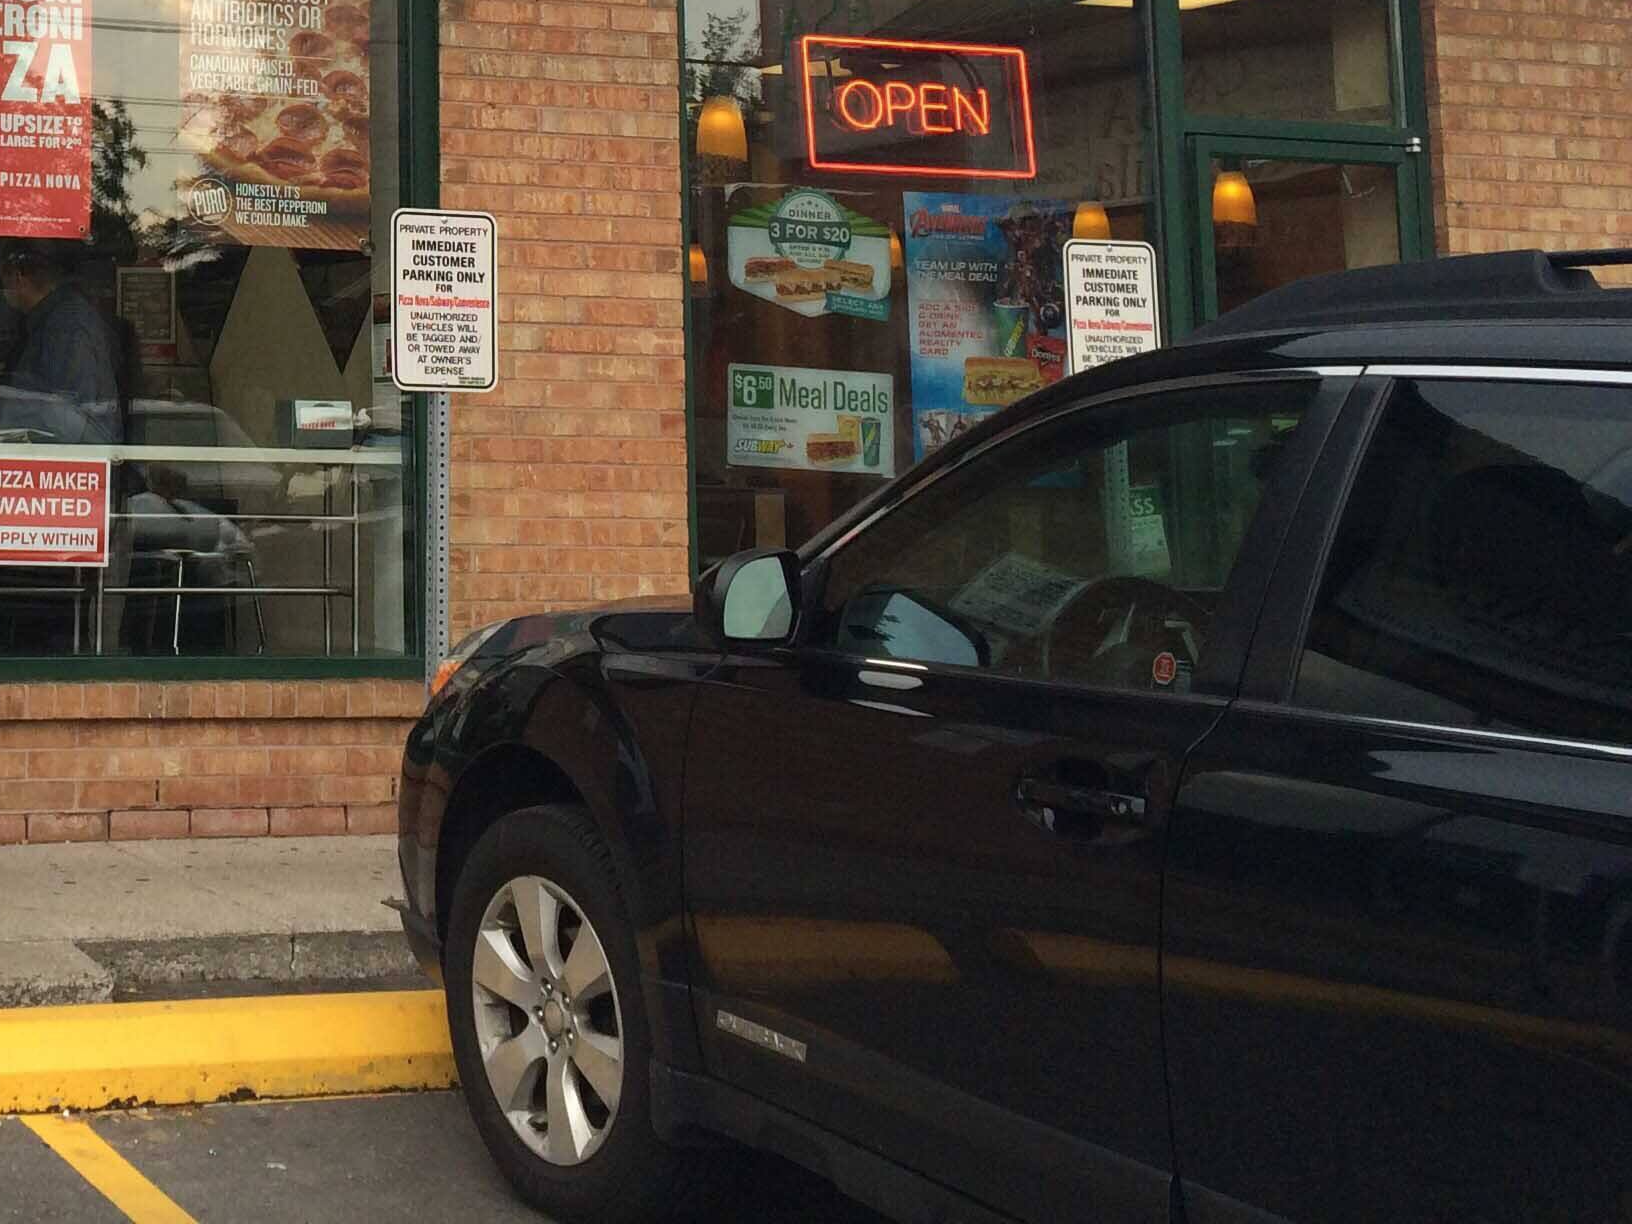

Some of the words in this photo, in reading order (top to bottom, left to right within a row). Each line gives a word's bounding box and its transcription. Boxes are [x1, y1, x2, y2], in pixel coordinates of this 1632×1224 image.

[299, 5, 321, 29] OR
[190, 54, 249, 73] CANADIAN
[190, 72, 254, 90] VEGETABLE
[838, 79, 990, 136] OPEN
[0, 113, 64, 135] UPSIZE
[66, 116, 82, 126] TO
[0, 135, 36, 147] LARGE
[39, 136, 60, 149] FOR
[0, 171, 41, 188] PIZZA
[46, 174, 81, 190] NOVA
[235, 183, 283, 198] HONESTLY,
[284, 186, 300, 199] IT'S
[194, 187, 228, 216] PURO
[235, 197, 253, 211] THE
[255, 198, 277, 212] BEST
[278, 200, 327, 214] PEPPERONI
[235, 212, 249, 225] WE
[251, 212, 280, 226] COULD
[789, 209, 832, 220] DINNER
[400, 224, 436, 235] PRIVATE
[439, 225, 488, 237] PROPERTY
[770, 222, 780, 238] 3
[786, 225, 817, 239] FOR
[823, 227, 850, 243] $20
[411, 240, 477, 254] IMMEDIATE
[413, 255, 475, 268] CUSTOMER
[915, 260, 948, 271] TEAM
[951, 261, 966, 271] UP
[968, 262, 997, 272] WITH
[1071, 254, 1102, 264] PRIVATE
[1105, 255, 1147, 265] PROPERTY
[402, 269, 454, 282] PARKING
[457, 270, 485, 283] ONLY
[939, 271, 966, 281] MEAL
[1082, 268, 1138, 281] IMMEDIATE
[436, 284, 453, 293] FOR
[1084, 282, 1138, 294] CUSTOMER
[1075, 296, 1120, 307] PARKING
[1123, 297, 1147, 308] ONLY
[410, 312, 478, 322] UNAUTHORIZED
[1105, 309, 1120, 317] FOR
[411, 322, 453, 332] VEHICLES
[457, 324, 477, 333] WILL
[406, 333, 417, 342] BE
[422, 334, 456, 343] TAGGED
[1085, 335, 1144, 344] UNAUTHORIZED
[408, 344, 420, 352] OR
[424, 345, 455, 353] TOWED
[459, 346, 480, 354] AWAY
[1086, 344, 1123, 353] VEHICLES
[417, 355, 427, 363] AT
[431, 355, 471, 365] OWNER'S
[424, 366, 464, 375] EXPENSE
[779, 377, 827, 410] Meal
[833, 381, 889, 414] Deals
[39, 472, 99, 491] MAKER
[41, 533, 96, 547] WITHIN
